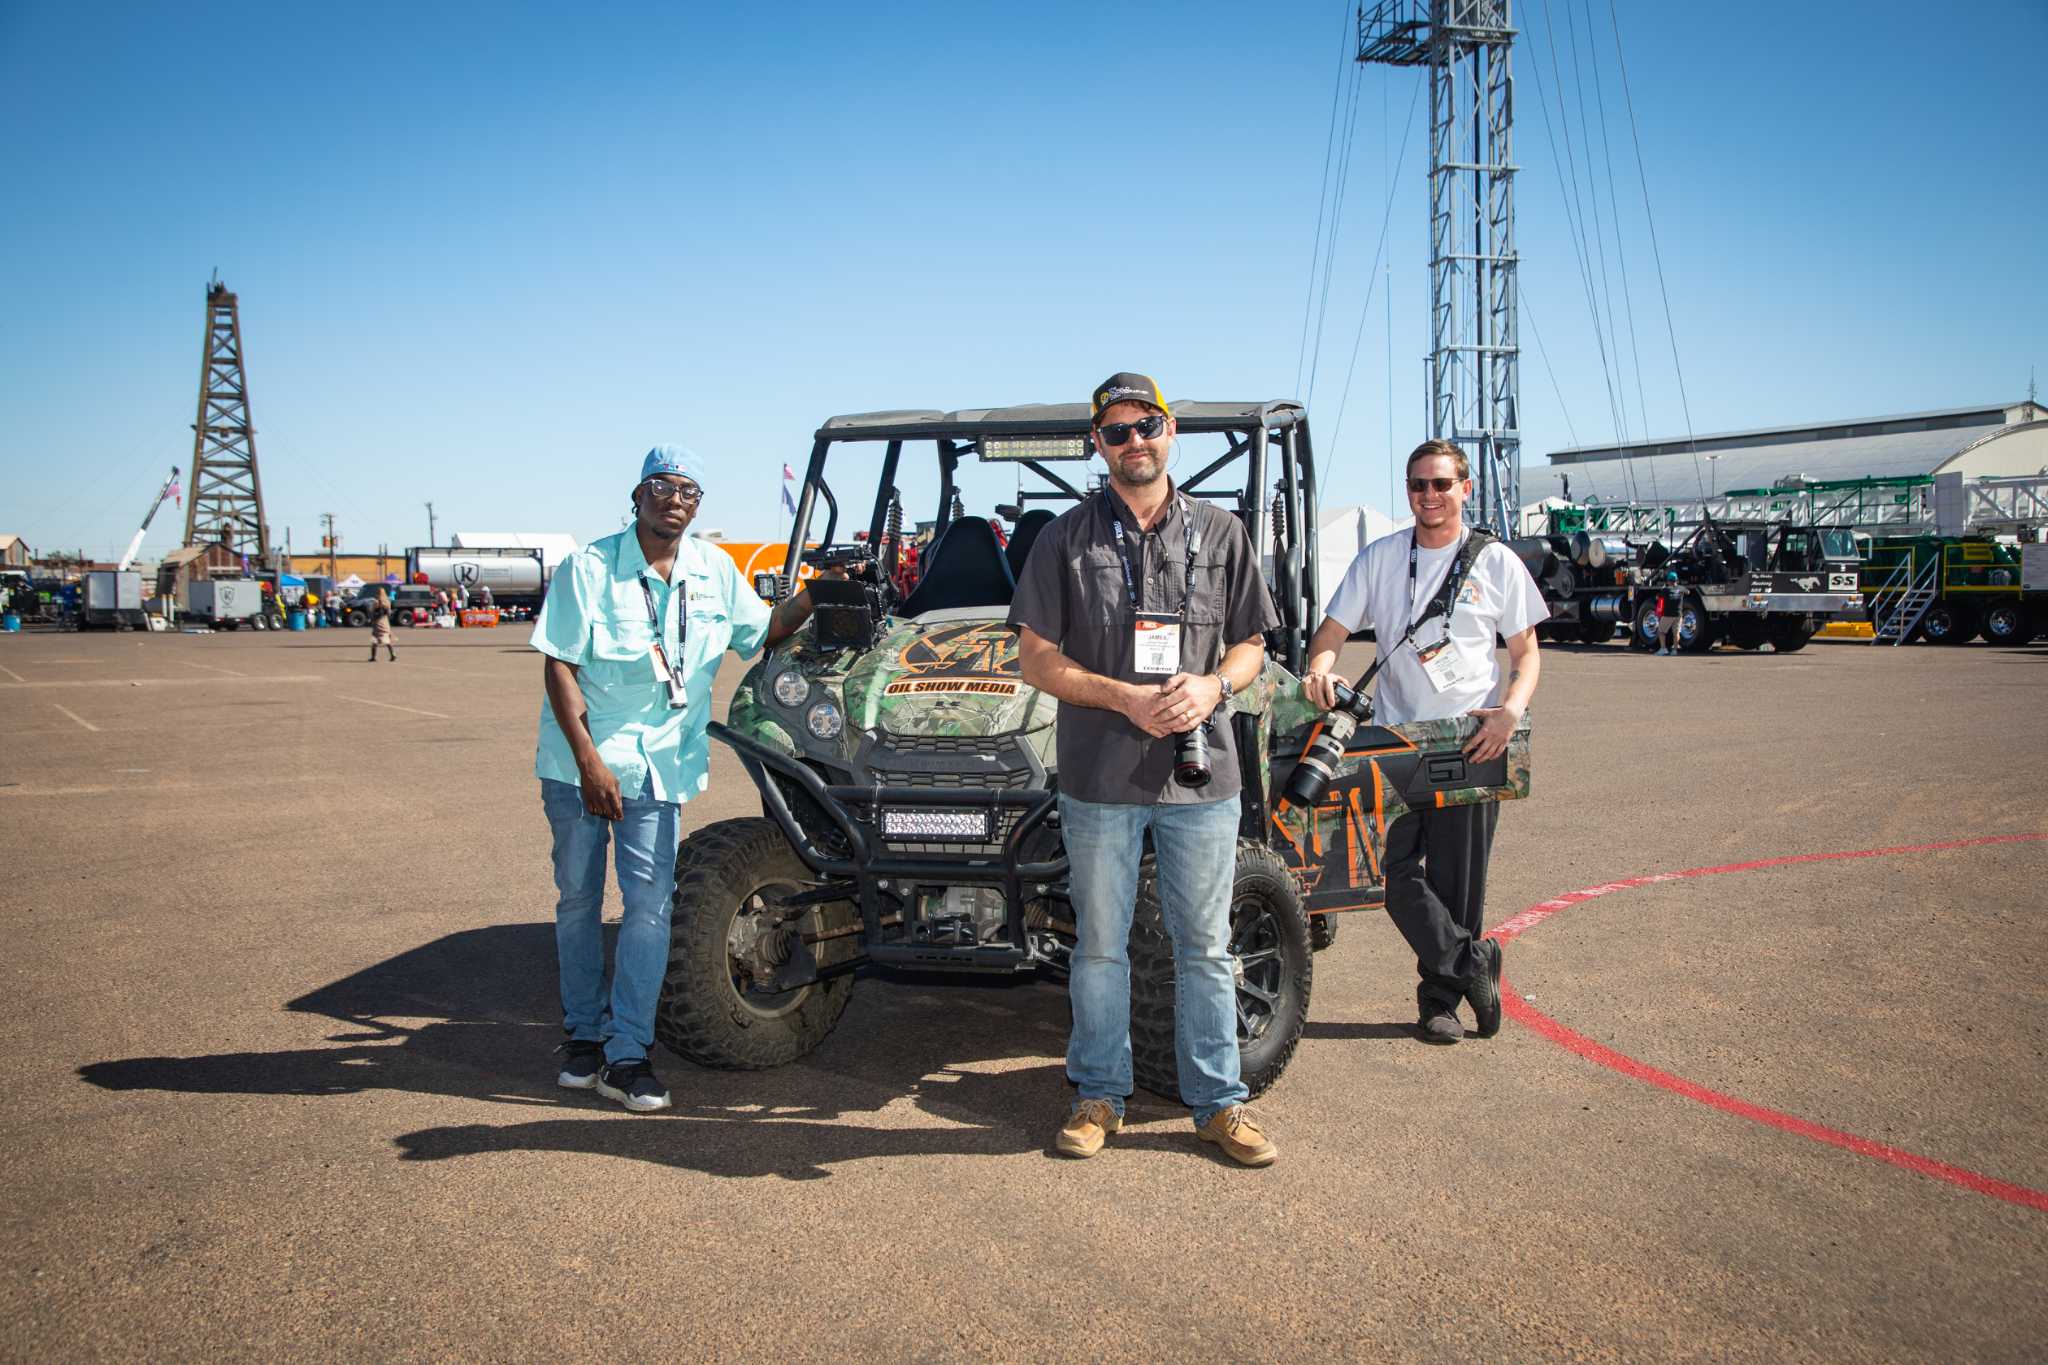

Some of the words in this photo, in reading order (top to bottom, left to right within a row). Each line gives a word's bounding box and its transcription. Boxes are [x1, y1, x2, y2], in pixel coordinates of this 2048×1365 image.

[460, 566, 473, 582] K
[888, 682, 912, 694] OIL
[913, 681, 964, 693] SHOW
[965, 682, 1016, 695] MEDIA
